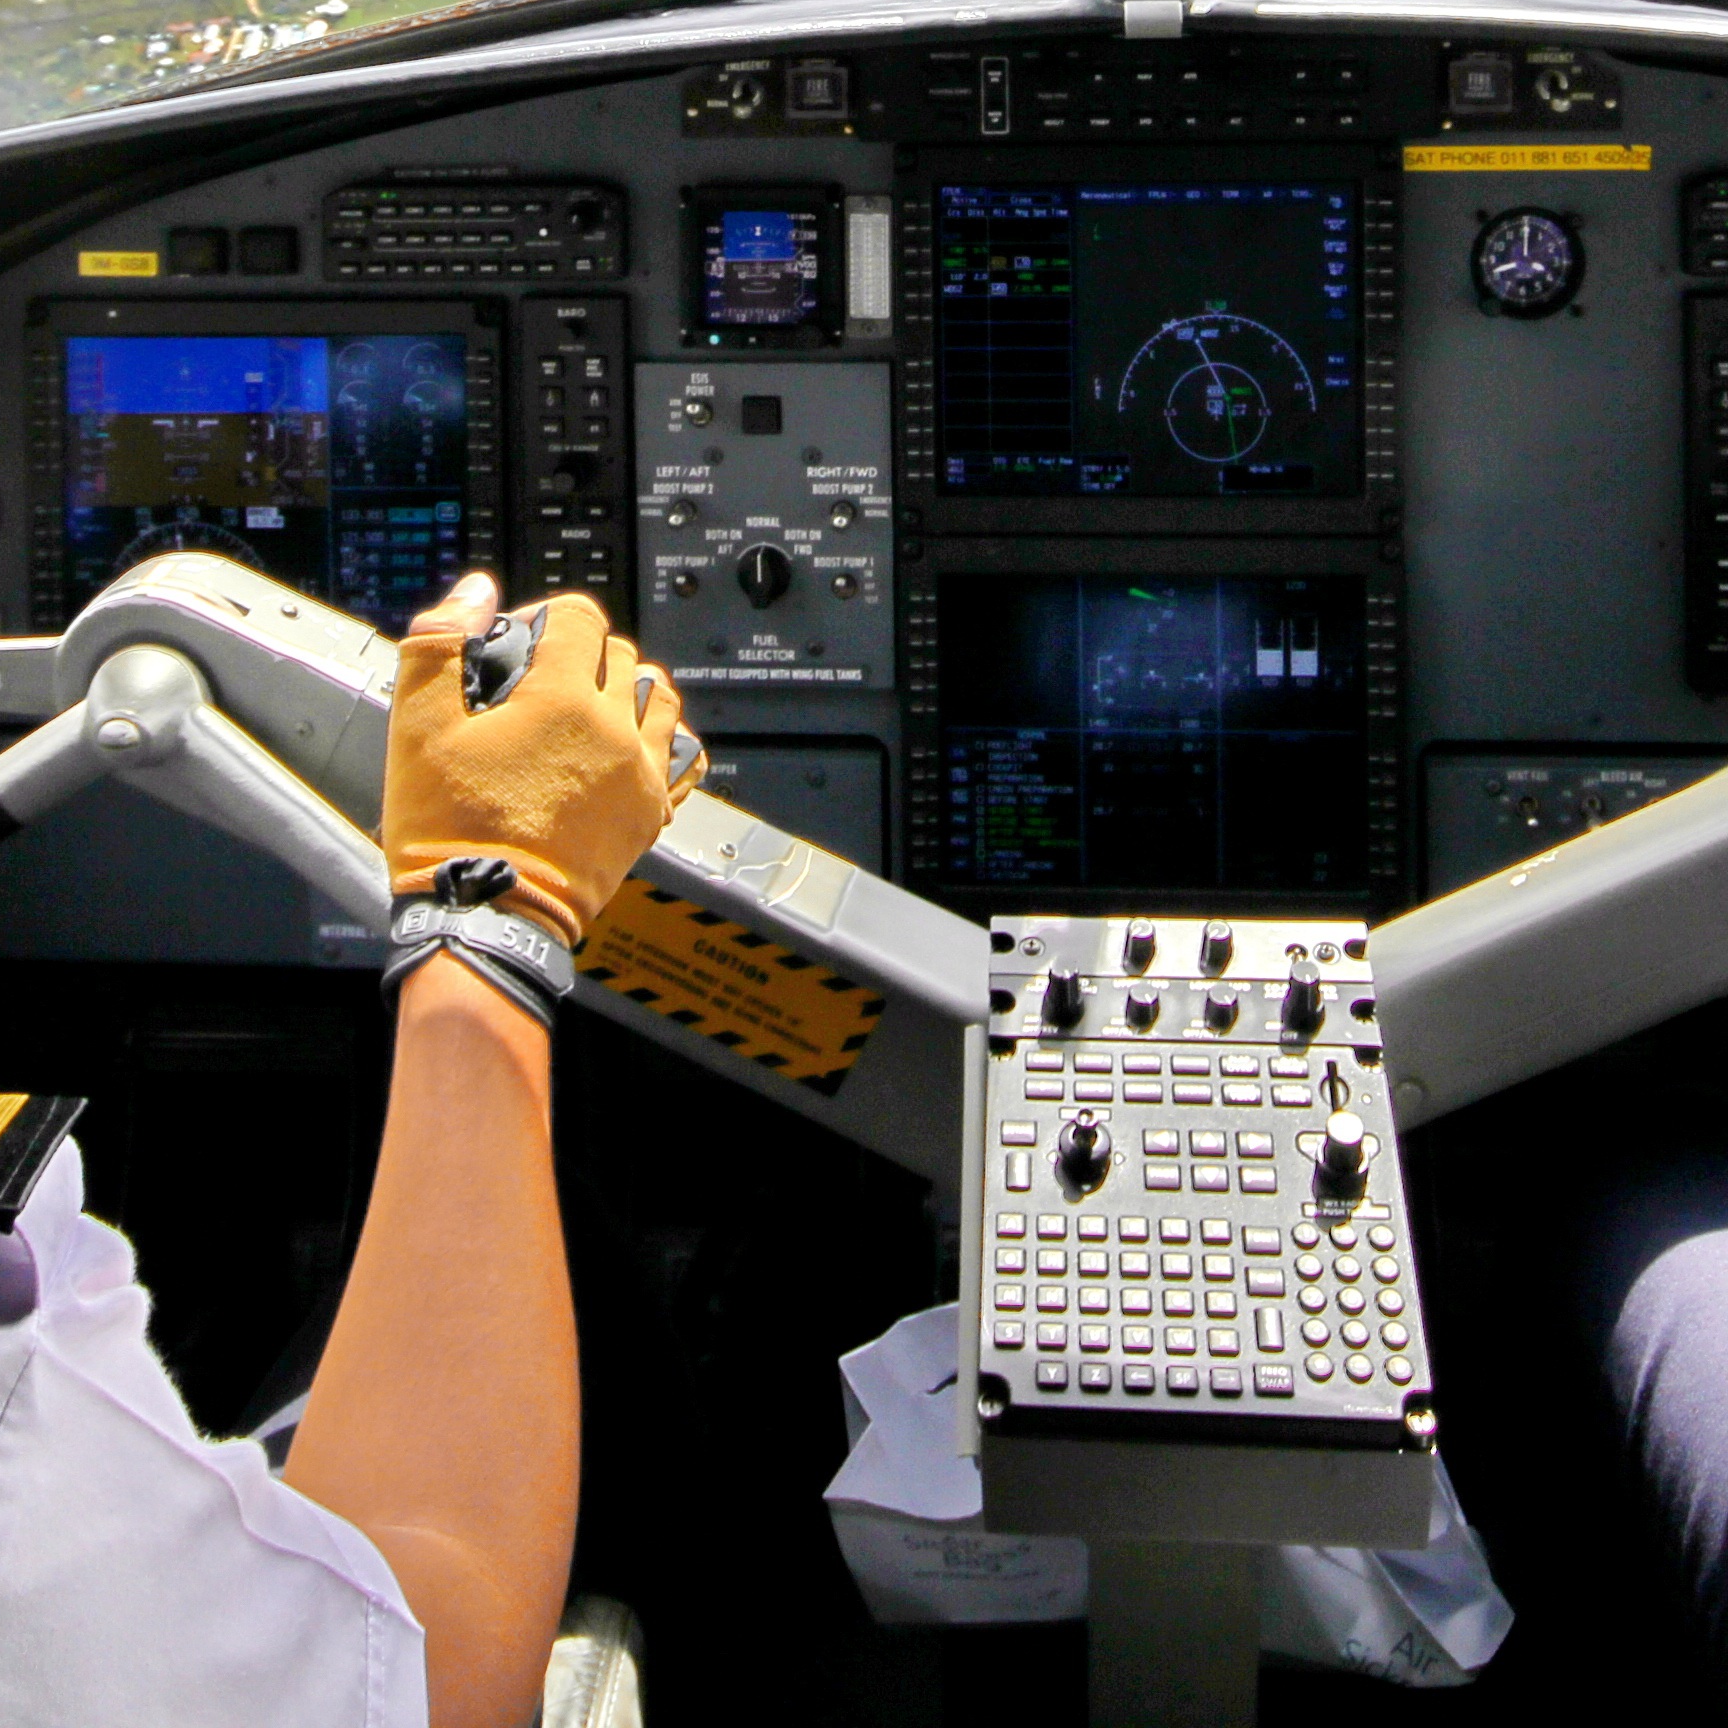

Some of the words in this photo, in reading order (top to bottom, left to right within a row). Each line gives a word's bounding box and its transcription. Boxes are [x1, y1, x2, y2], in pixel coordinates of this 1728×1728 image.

[1405, 152, 1433, 165] SAT
[1440, 152, 1496, 165] PHONE
[1501, 152, 1526, 164] 011
[557, 308, 586, 318] BARO
[691, 373, 709, 384] ESIS
[686, 385, 714, 396] POWER
[653, 483, 680, 495] BOOST
[682, 483, 706, 495] PUMP
[708, 483, 714, 494] 2
[812, 483, 839, 495] BOOST
[842, 483, 867, 495] PUMP
[867, 483, 874, 494] 2
[746, 517, 780, 528] NORMAL
[561, 529, 591, 540] RADIO
[705, 530, 728, 541] BOTH
[729, 530, 743, 540] ON
[784, 530, 807, 541] BOTH
[808, 530, 822, 541] ON
[717, 544, 733, 555] AFT
[793, 544, 813, 556] FWD
[655, 556, 683, 567] BOOST
[684, 556, 709, 567] PUMP
[813, 557, 841, 568] BOOST
[843, 557, 868, 568] PUMP
[752, 635, 778, 646] FUEL
[738, 650, 795, 661] SELECTOR
[673, 668, 709, 680] AIRCRAFT
[711, 668, 727, 680] NOT
[729, 668, 768, 680] EQUIPPED
[770, 668, 790, 680] WITH
[792, 668, 813, 680] WING
[815, 668, 834, 680] FUEL
[836, 668, 862, 680] TANKS
[499, 921, 551, 970] 5.11
[693, 938, 769, 985] CAUTION
[1261, 1366, 1288, 1376] FREQ
[1261, 1378, 1290, 1388] SWAP
